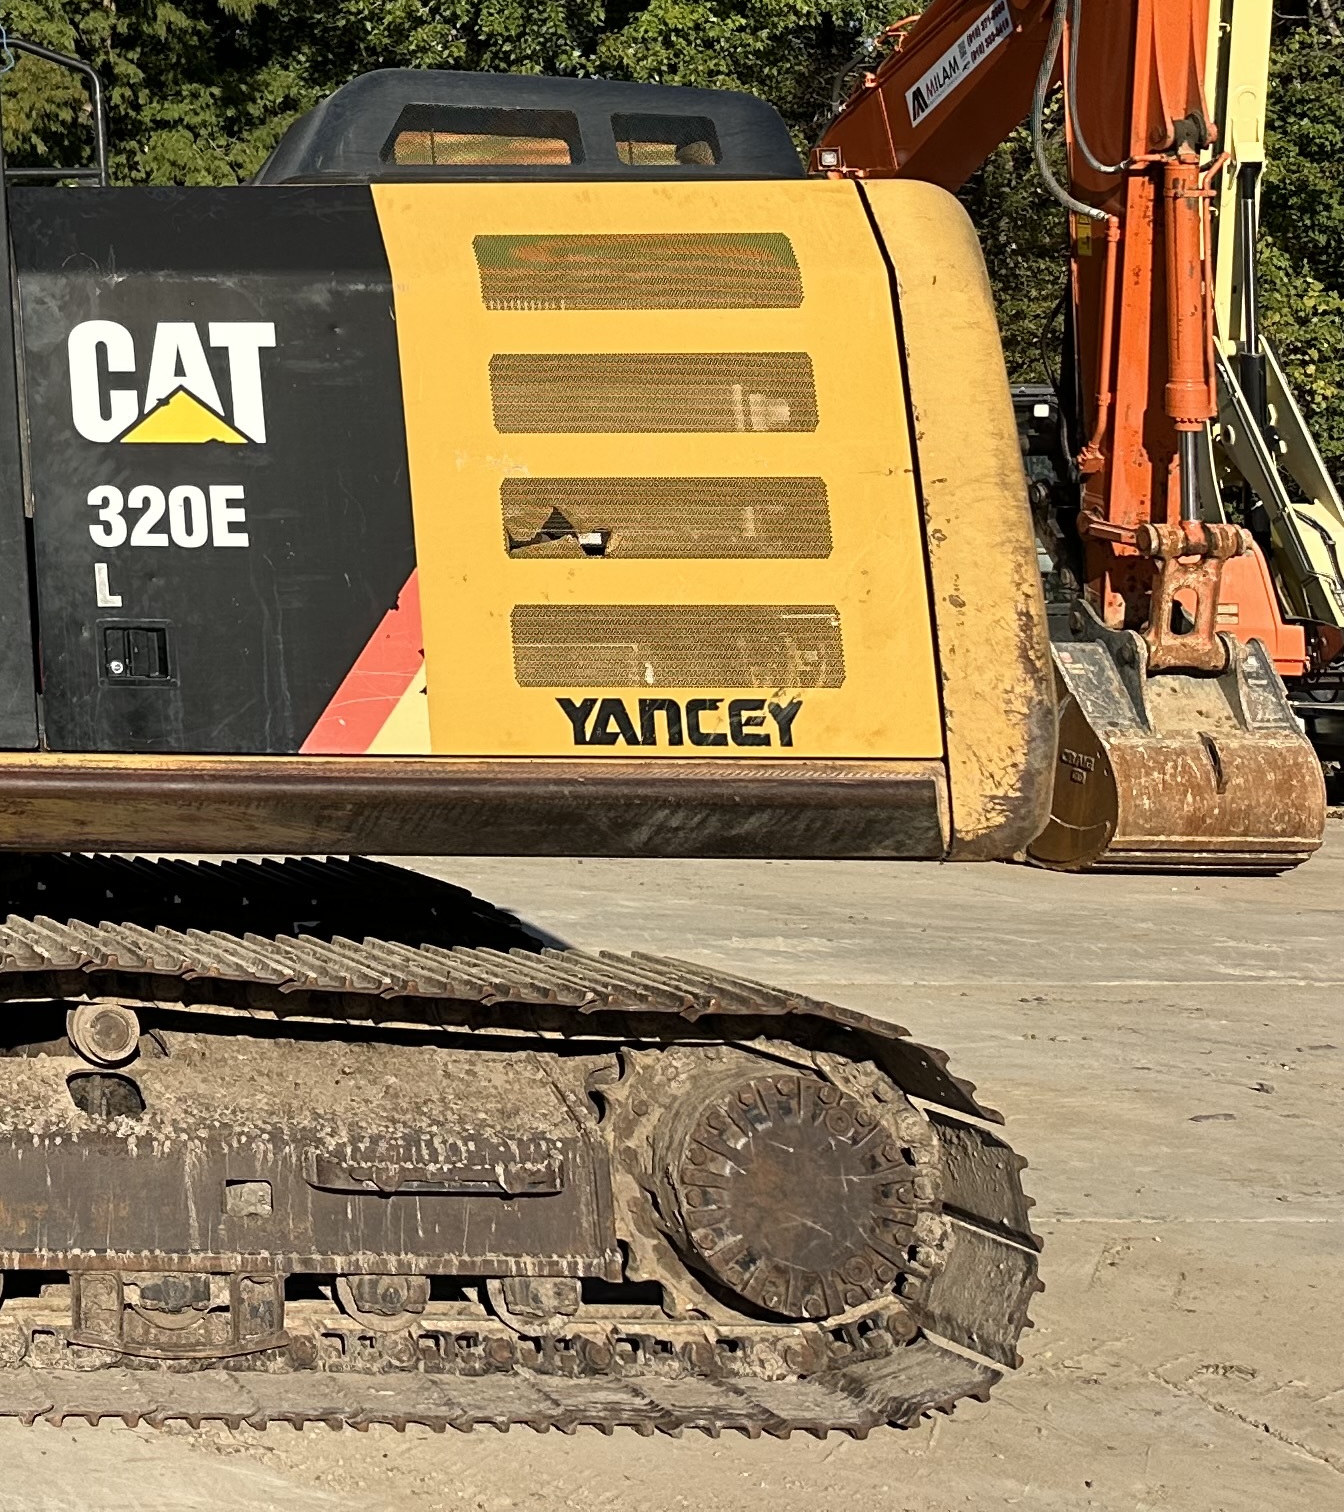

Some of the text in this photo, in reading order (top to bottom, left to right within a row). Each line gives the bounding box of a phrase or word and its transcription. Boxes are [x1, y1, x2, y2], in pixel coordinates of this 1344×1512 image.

[925, 55, 960, 100] MILAM
[67, 319, 276, 444] CAT
[87, 484, 249, 548] 320E
[95, 562, 123, 608] L
[554, 696, 804, 747] YANCEY
